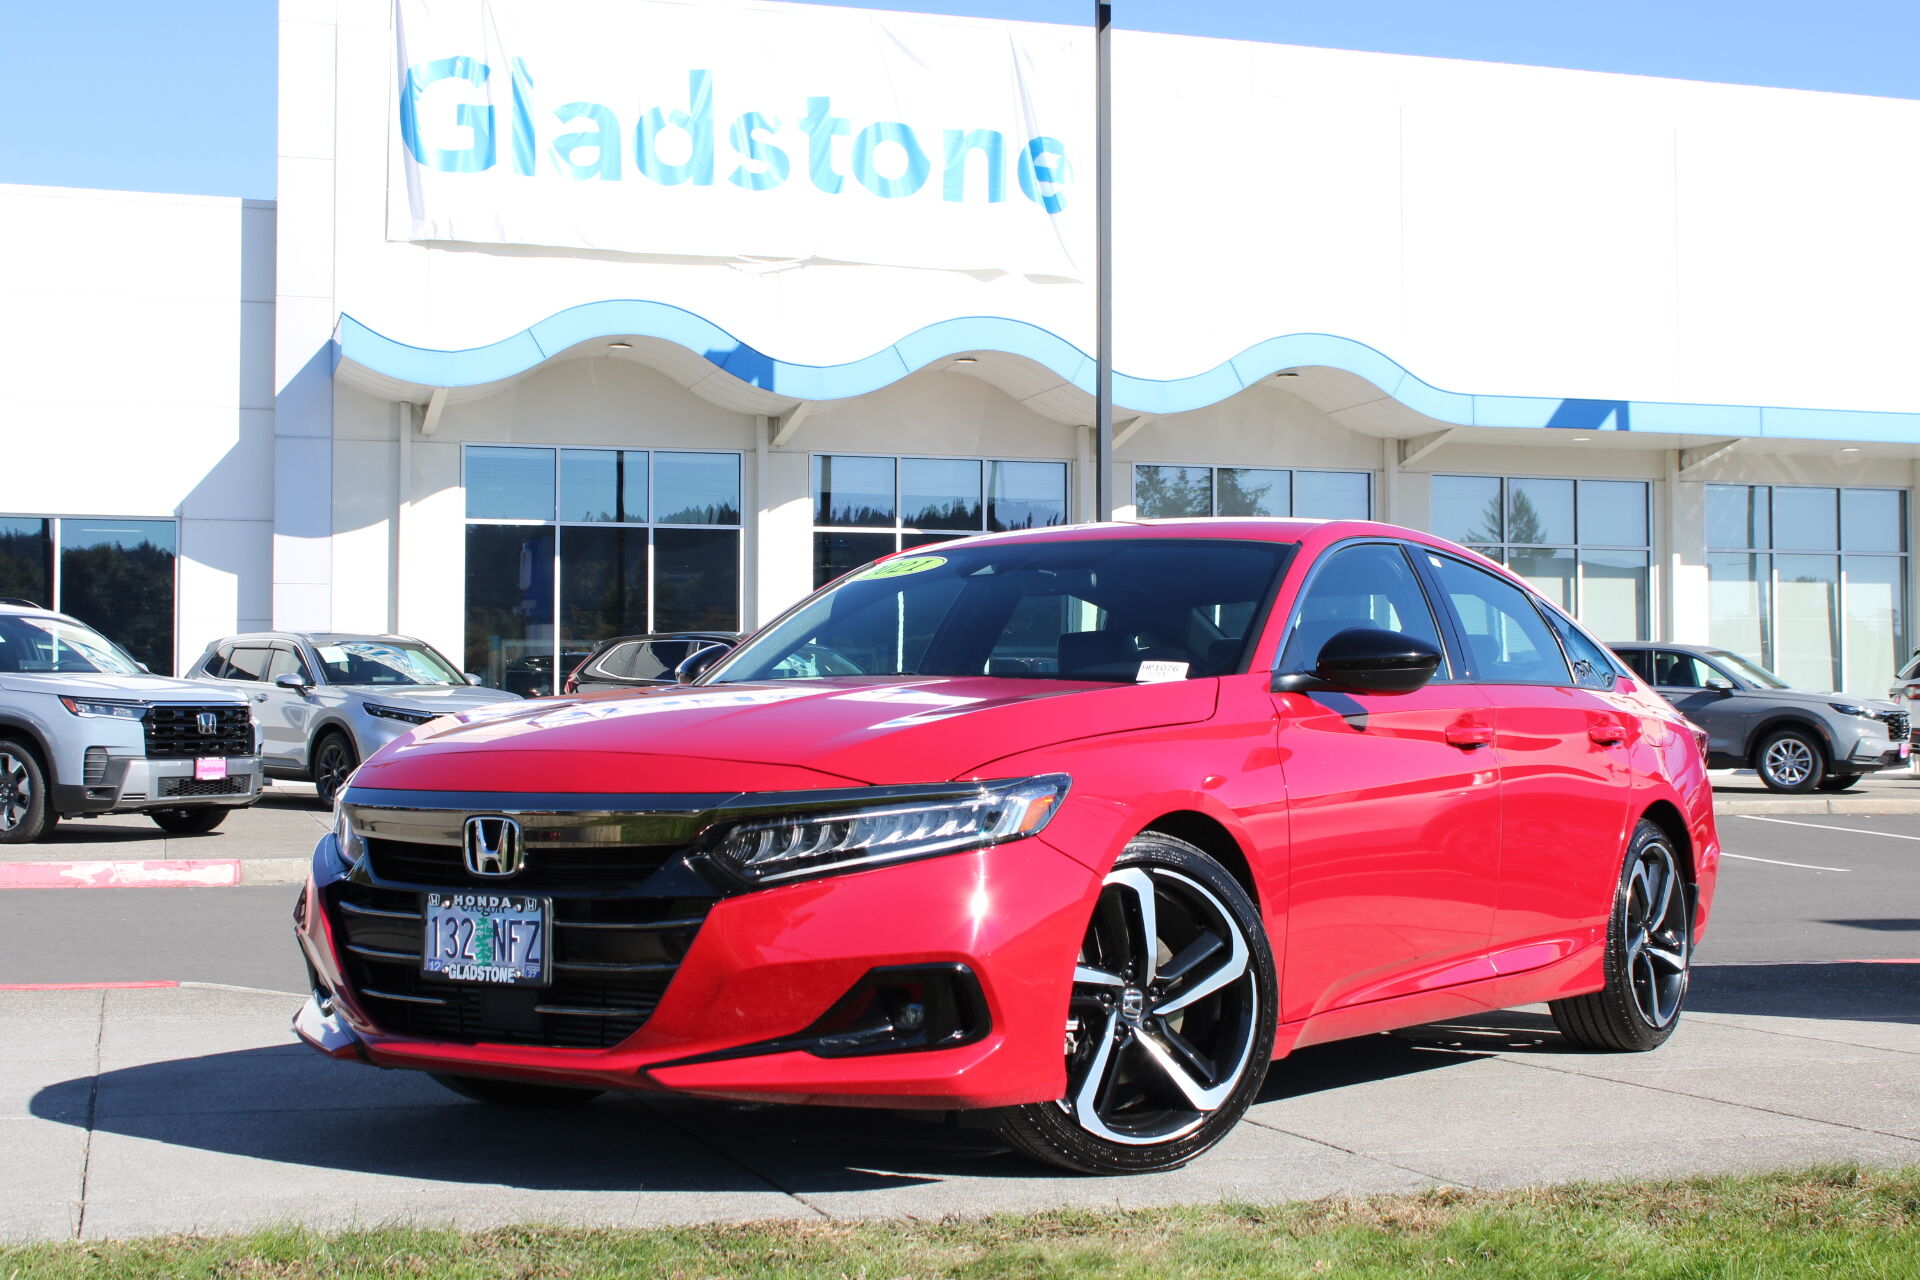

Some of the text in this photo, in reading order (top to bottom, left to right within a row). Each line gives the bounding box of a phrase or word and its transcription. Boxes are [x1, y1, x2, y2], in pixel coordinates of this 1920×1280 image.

[400, 55, 1072, 215] Gladstone
[454, 895, 511, 908] HONDA
[431, 916, 540, 963] 132 NFZ
[430, 961, 440, 970] 12
[448, 964, 515, 984] GLADSTONE
